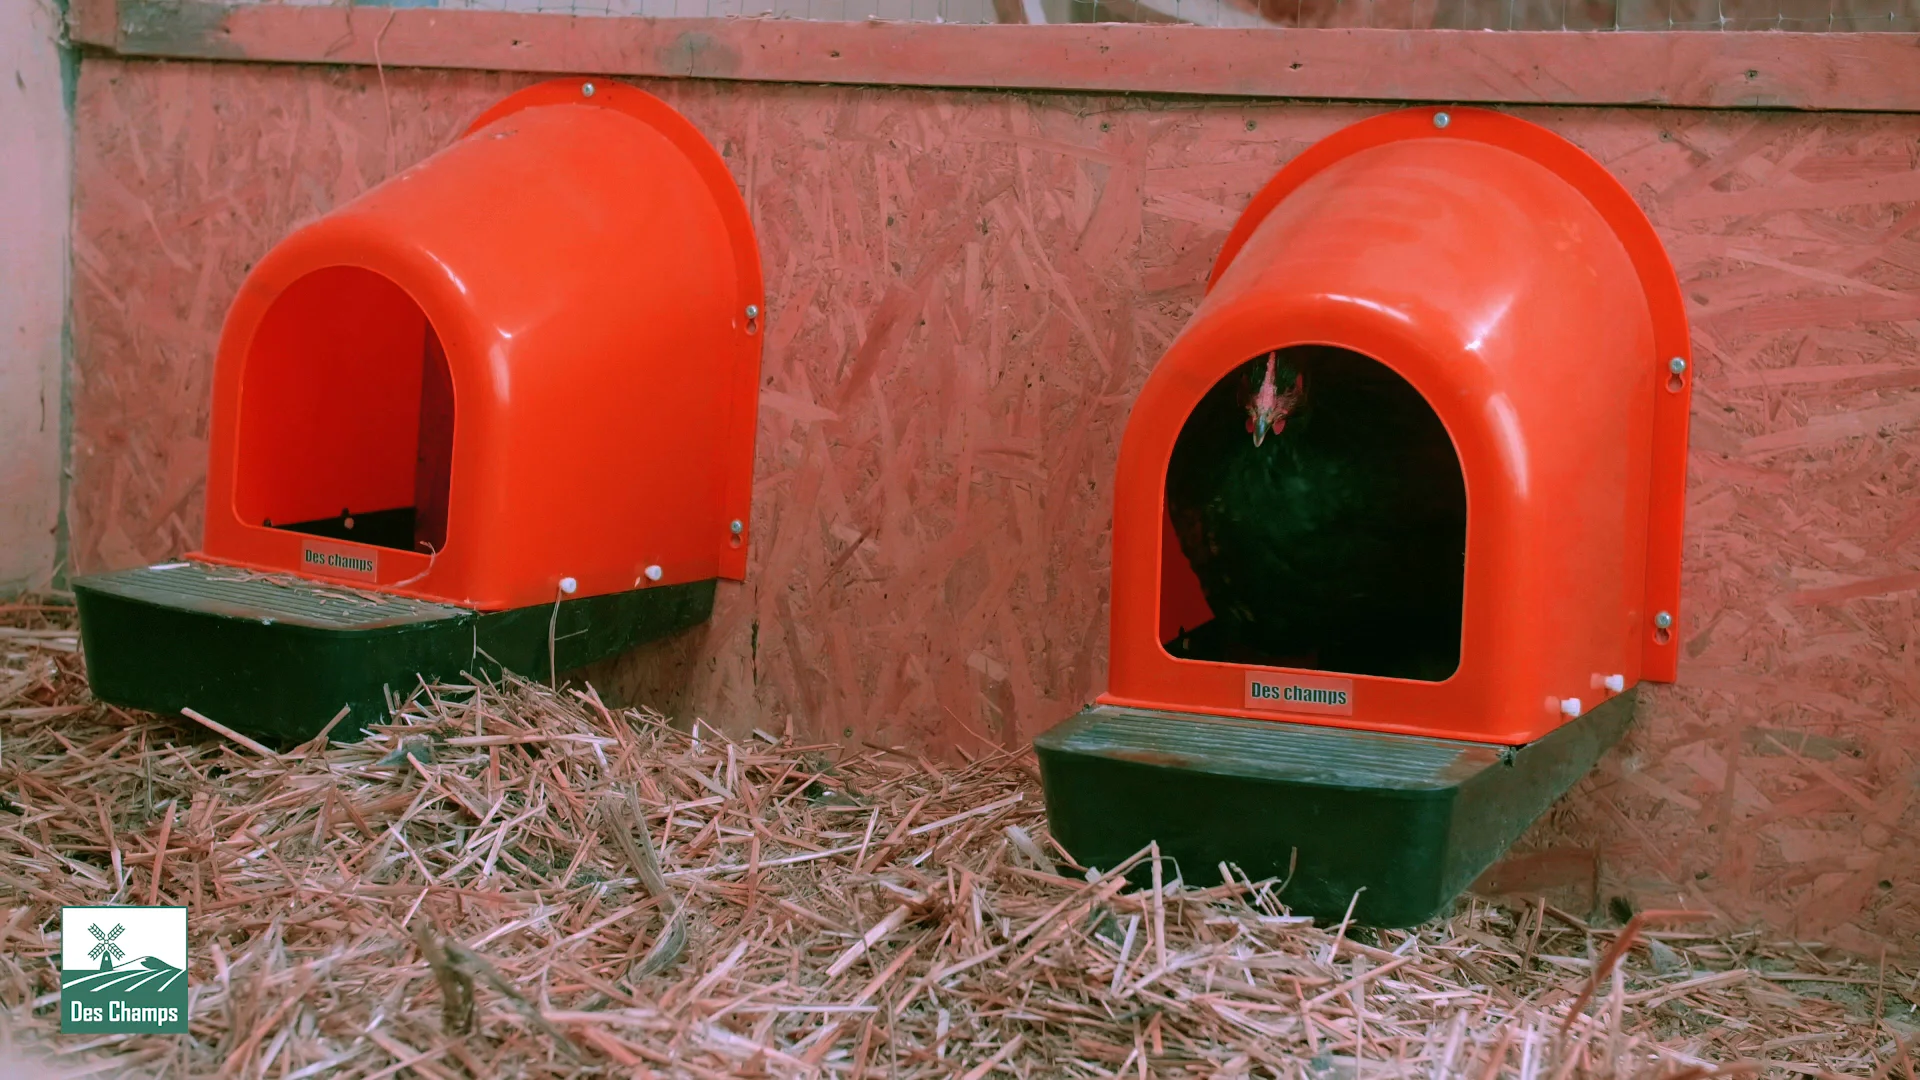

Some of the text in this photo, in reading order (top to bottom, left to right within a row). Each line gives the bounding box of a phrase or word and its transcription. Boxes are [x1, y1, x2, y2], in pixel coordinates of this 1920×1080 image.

[305, 549, 373, 572] Des champs
[1251, 682, 1347, 705] Des champs
